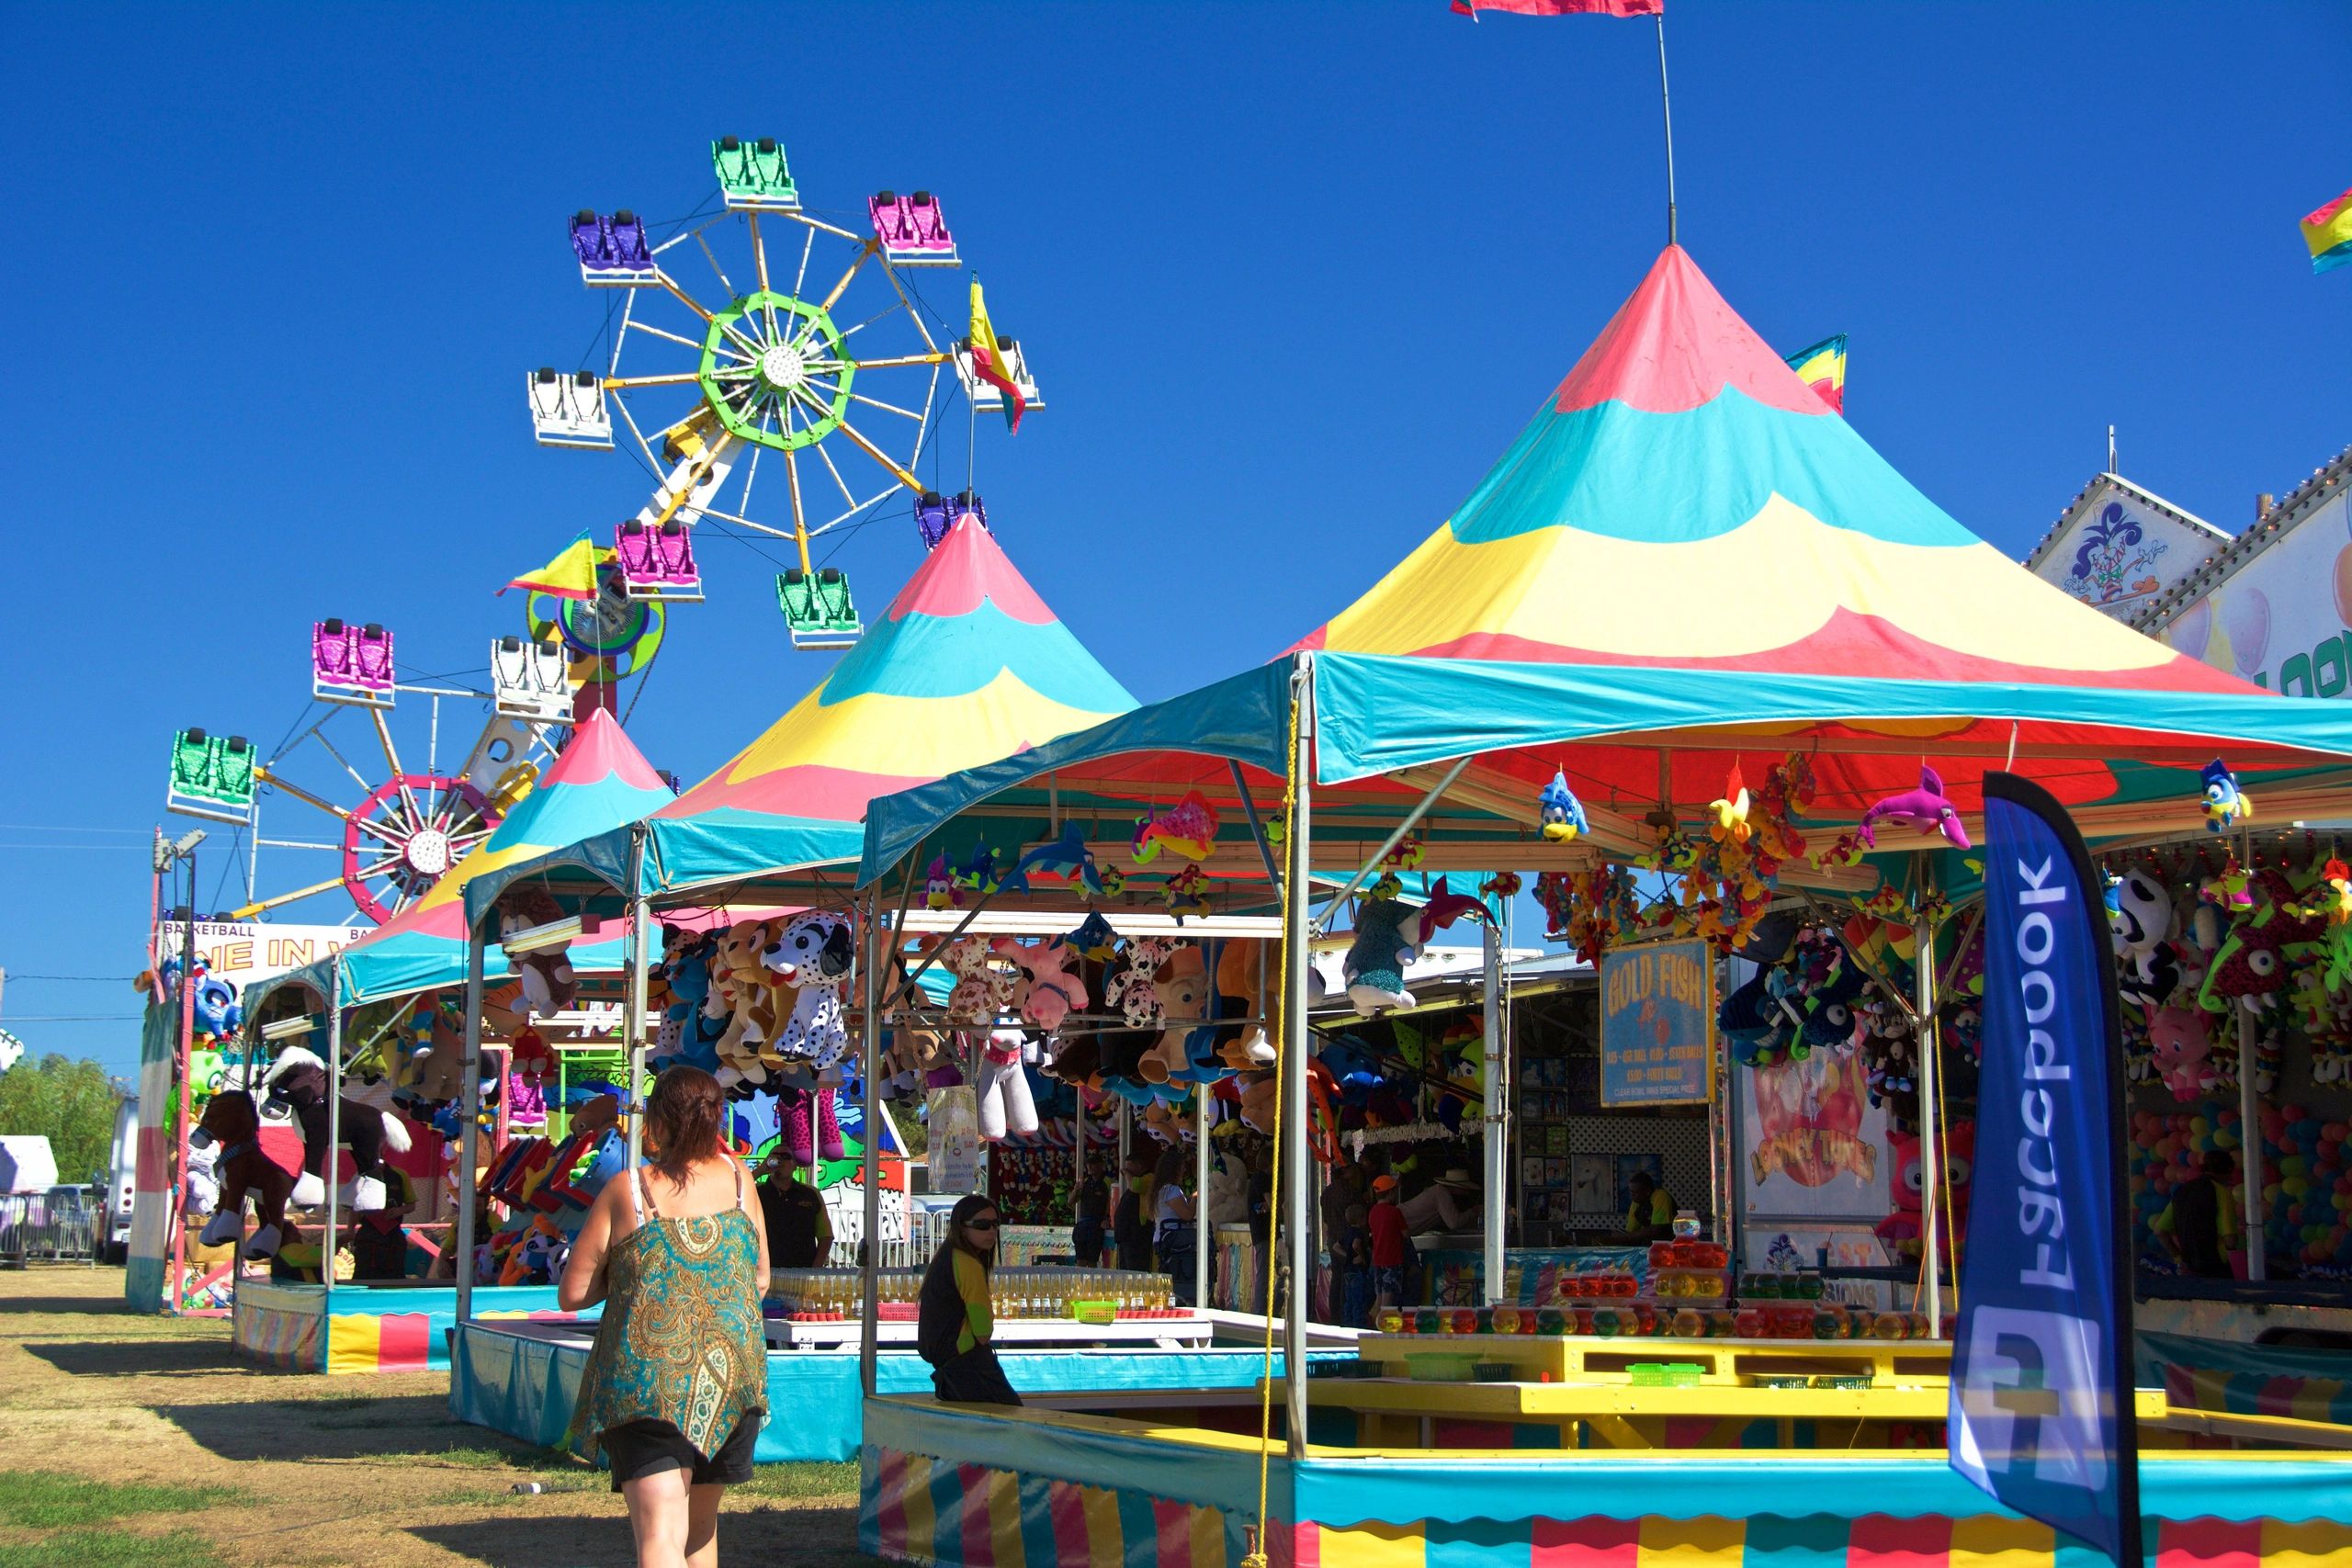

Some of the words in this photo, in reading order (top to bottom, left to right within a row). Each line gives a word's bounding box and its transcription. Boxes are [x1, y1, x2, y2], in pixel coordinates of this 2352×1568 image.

[164, 923, 254, 936] BAKETBALL
[268, 939, 313, 966] IN
[1608, 953, 1652, 1018] GOLD
[1659, 953, 1702, 1011] FISH
[1750, 1127, 1816, 1187] LOONEY
[1819, 1129, 1877, 1184] TUNES
